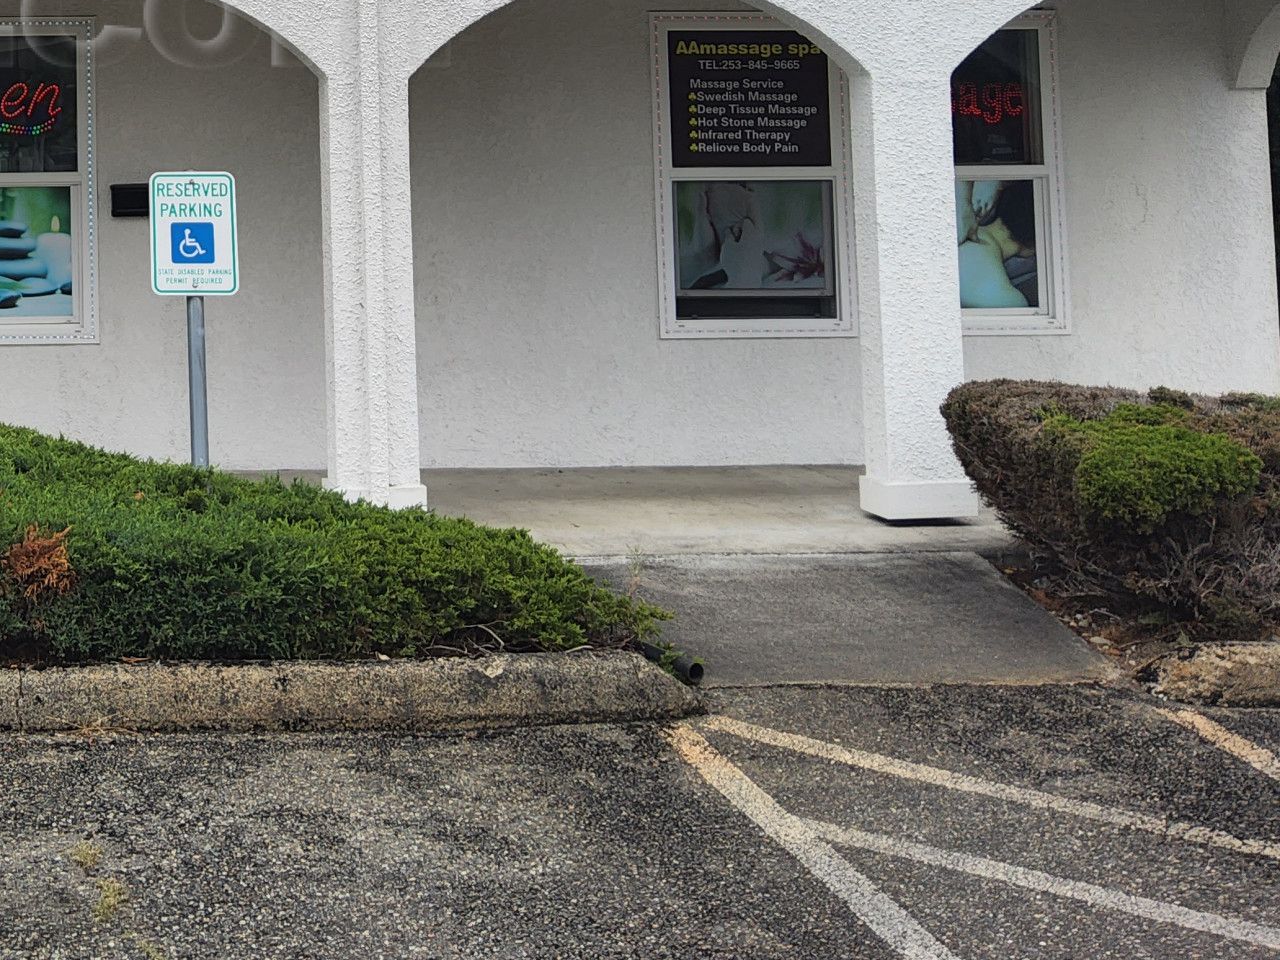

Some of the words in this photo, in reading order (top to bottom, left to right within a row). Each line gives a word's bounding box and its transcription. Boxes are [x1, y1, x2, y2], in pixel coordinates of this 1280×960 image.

[676, 41, 783, 58] AAmassage
[788, 43, 821, 58] spa
[698, 59, 800, 70] TEL:253-845-9665
[689, 78, 740, 91] Massage
[743, 78, 784, 89] Service
[696, 91, 745, 102] Swedish
[748, 91, 798, 104] Massage
[951, 81, 1024, 124] age
[697, 104, 726, 117] Deep
[729, 103, 765, 114] Tissue
[768, 104, 818, 117] Massage
[697, 117, 718, 128] Hot
[721, 117, 754, 128] Stone
[757, 117, 808, 130] Massage
[698, 129, 742, 140] Infrared
[744, 129, 791, 143] Therapy
[743, 142, 771, 155] Body
[774, 142, 799, 153] Pain
[156, 182, 228, 197] RESERVED
[160, 202, 223, 218] PARKING
[158, 268, 175, 276] STATE
[177, 268, 205, 276] DISABLED
[207, 268, 233, 276] PARKING
[165, 277, 188, 285] PERMIT
[192, 277, 223, 285] REQUIRED
